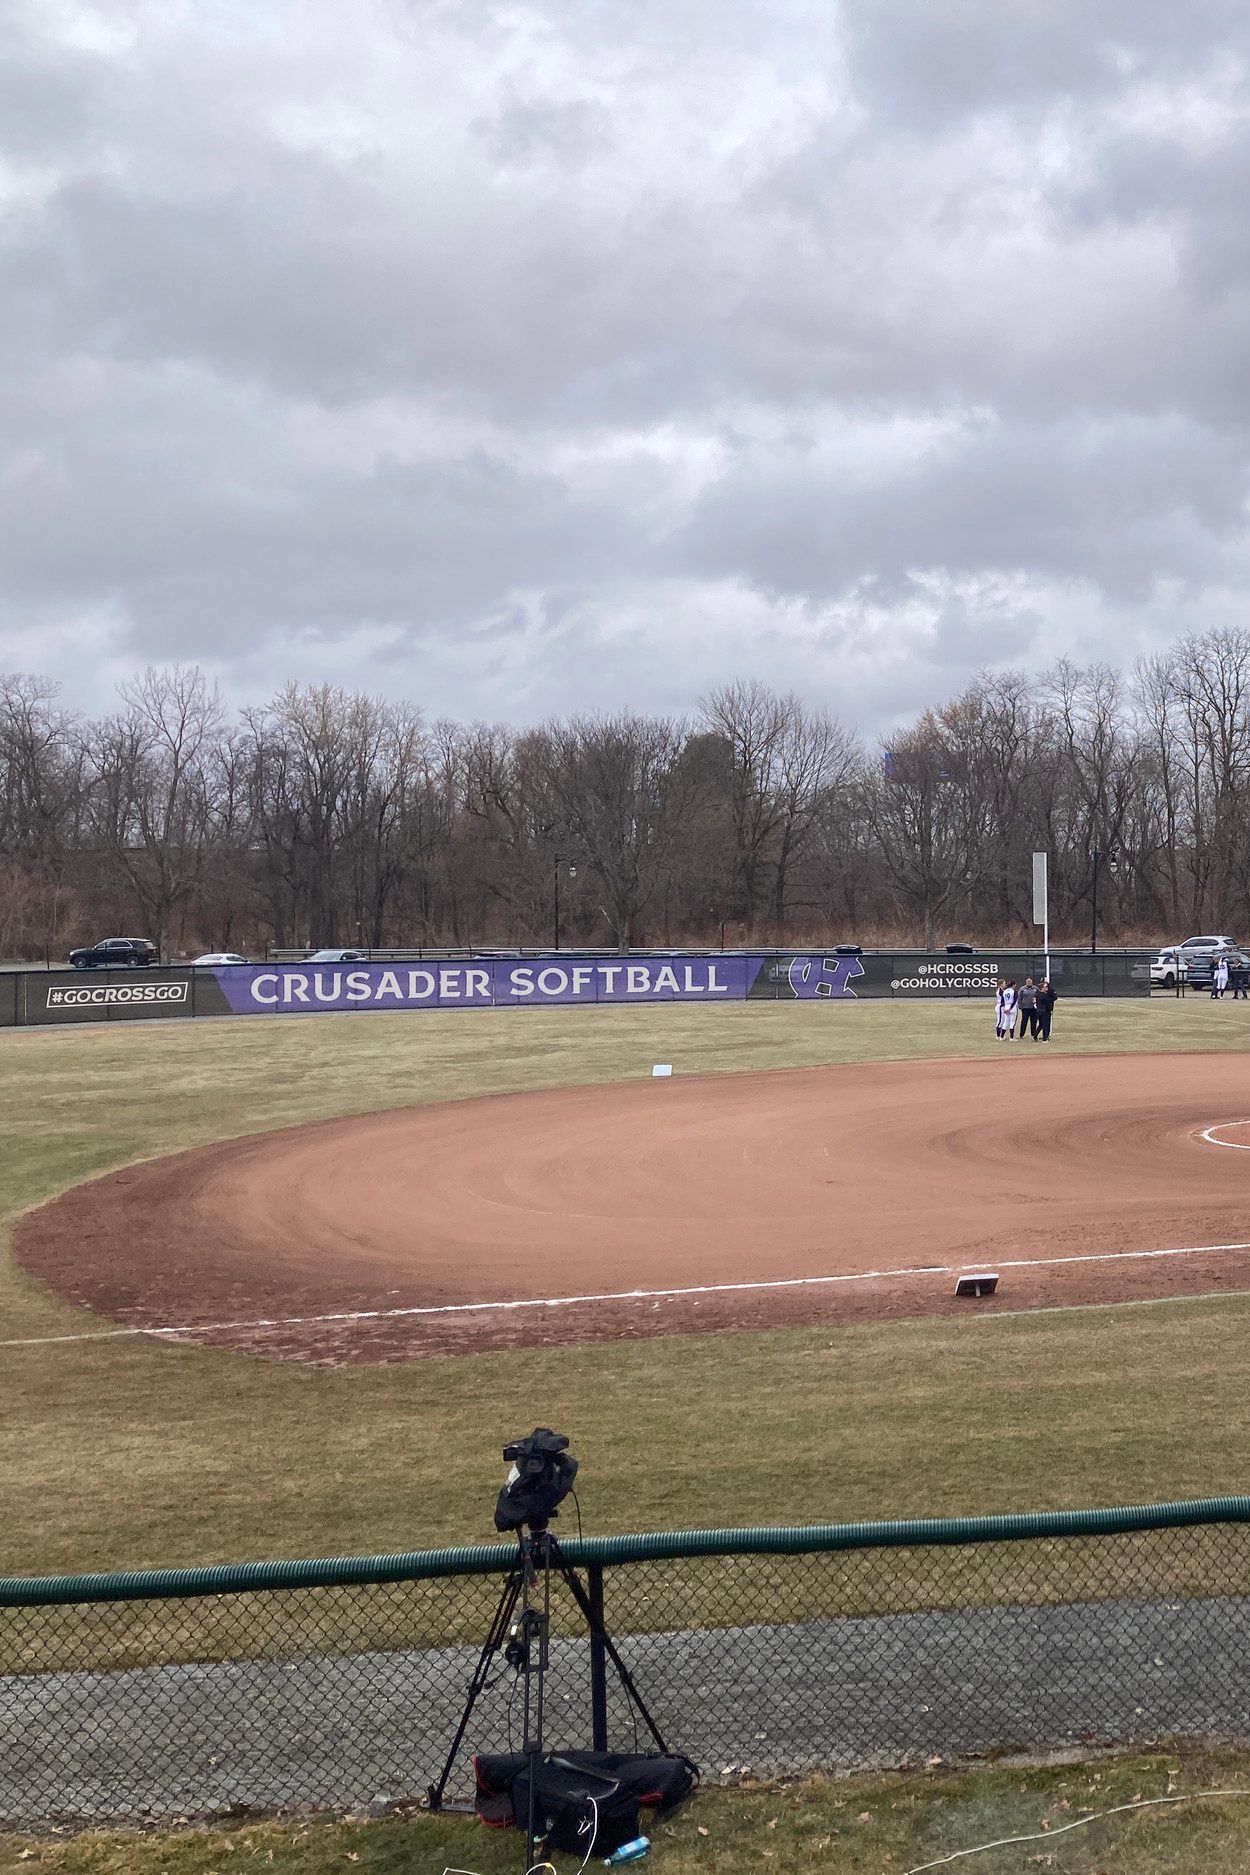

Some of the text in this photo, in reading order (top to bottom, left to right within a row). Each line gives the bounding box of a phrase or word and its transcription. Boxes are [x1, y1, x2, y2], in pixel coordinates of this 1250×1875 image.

[918, 963, 999, 975] @HCROSSSB
[250, 965, 728, 1004] CRUSADER SOFTBALL
[890, 978, 998, 989] @GOHOLYCROSS
[51, 987, 182, 1003] #GOCROSSGO
